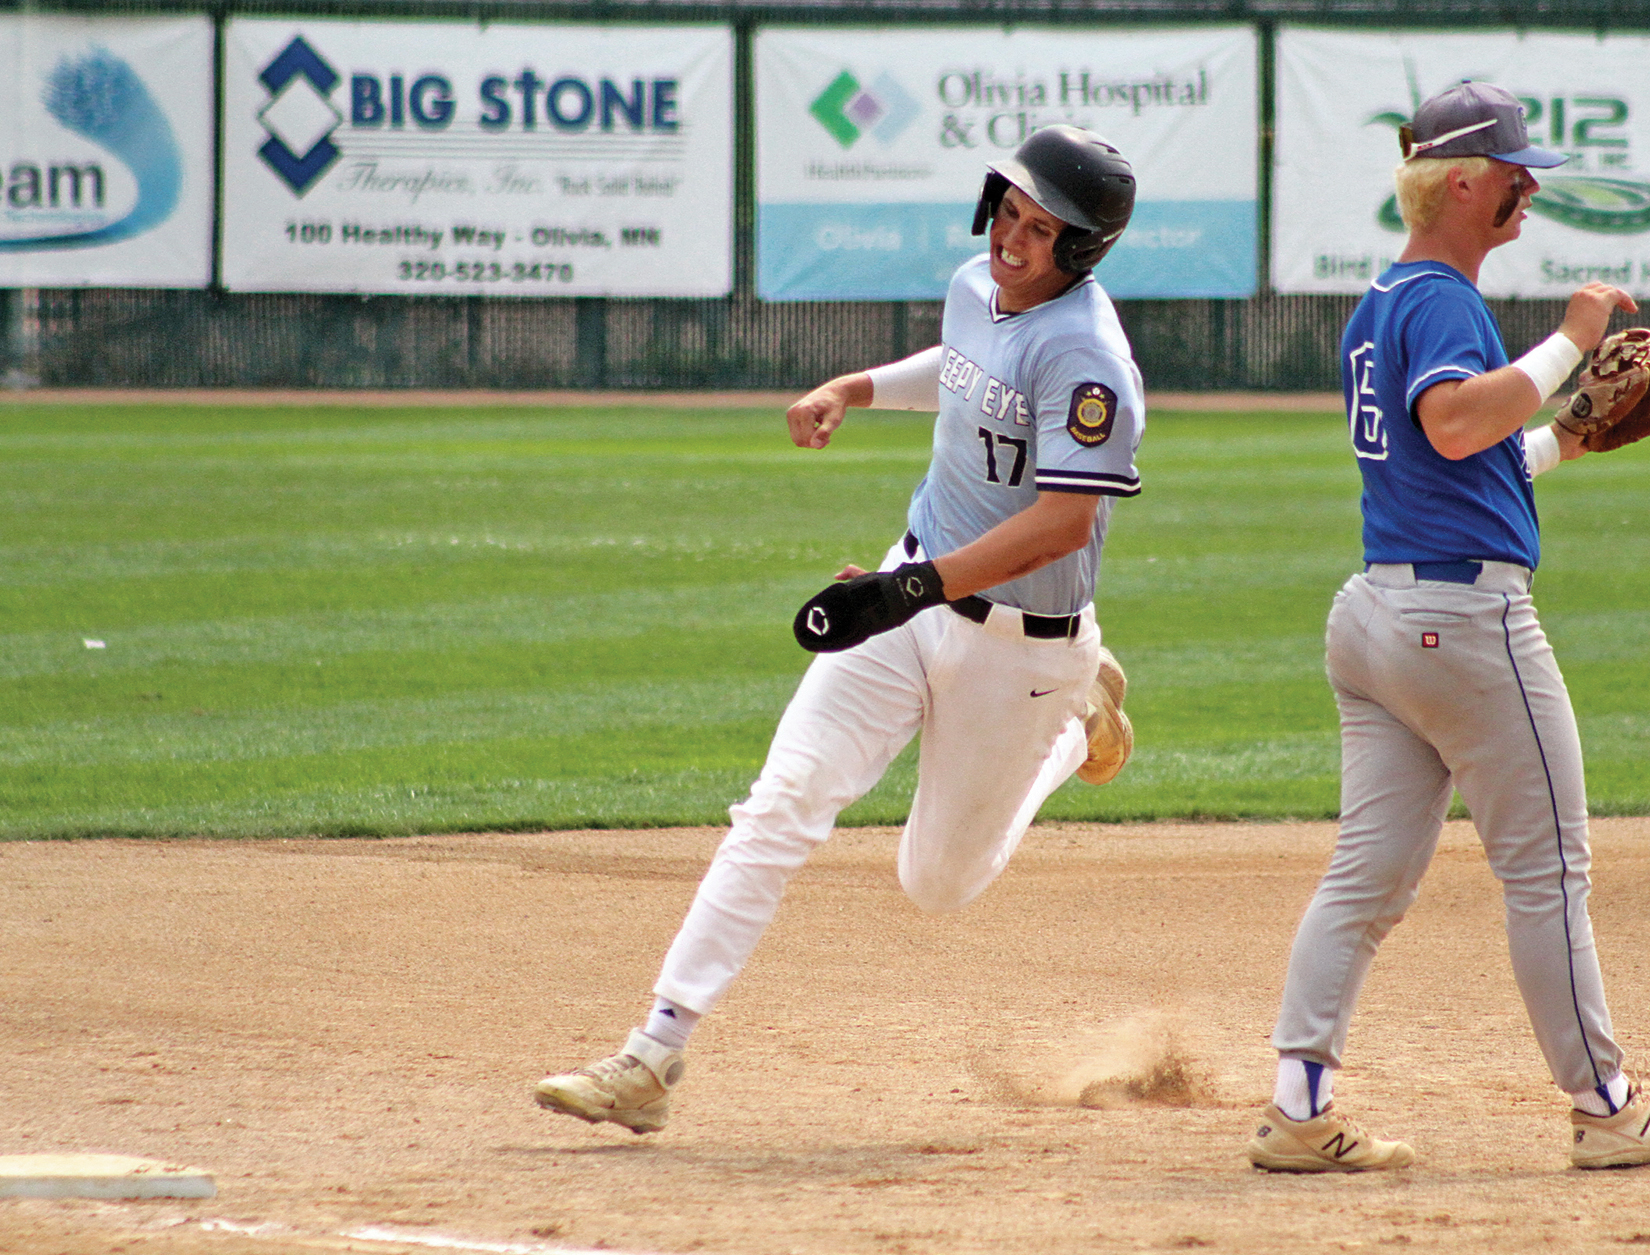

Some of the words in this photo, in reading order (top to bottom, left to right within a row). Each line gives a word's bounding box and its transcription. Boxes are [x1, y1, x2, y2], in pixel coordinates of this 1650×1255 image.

[351, 75, 456, 131] BIG
[938, 71, 1047, 108] Olivia
[1059, 70, 1208, 117] Hospital
[939, 114, 977, 149] &
[0, 163, 106, 209] am
[285, 224, 333, 245] 100
[341, 225, 444, 250] Healthy
[453, 226, 505, 251] Way
[1313, 254, 1372, 279] Bird
[1541, 258, 1633, 283] Sacred
[940, 344, 984, 402] EEPY
[980, 375, 1031, 427] EYE
[1070, 426, 1106, 443] BASEBALL
[978, 426, 1027, 487] 17
